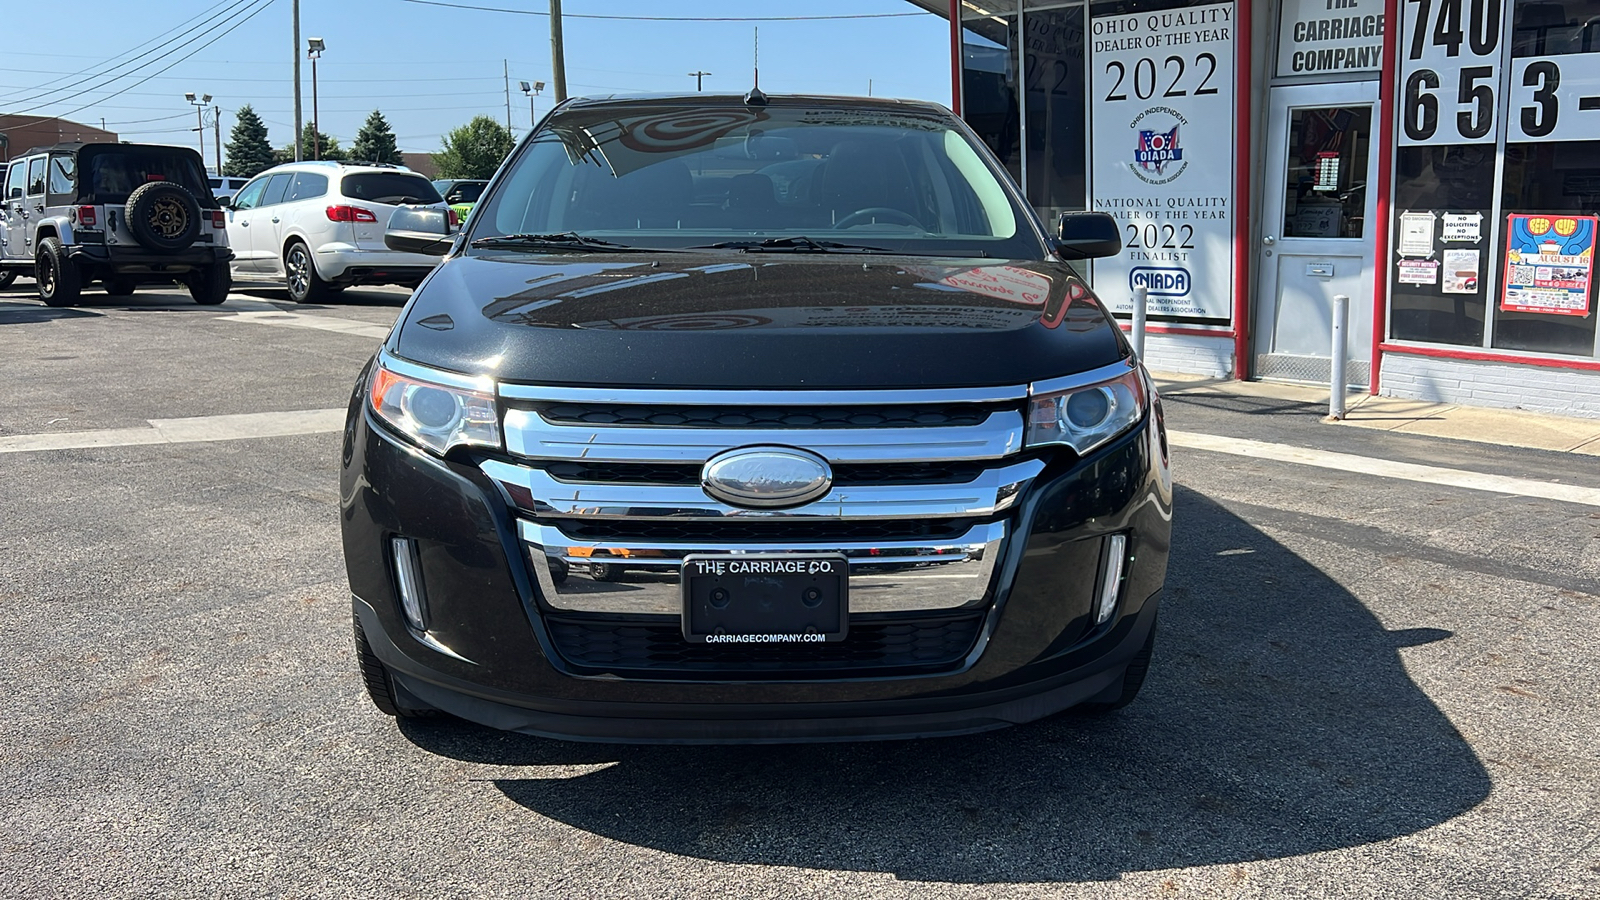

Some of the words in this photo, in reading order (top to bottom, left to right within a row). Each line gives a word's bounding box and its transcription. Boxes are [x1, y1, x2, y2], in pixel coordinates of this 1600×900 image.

[1093, 18, 1138, 36] OHIO
[1147, 7, 1233, 32] QUALITY
[1294, 15, 1384, 43] CARRIAGE
[1408, 0, 1499, 60] 740
[1095, 37, 1143, 53] DEALER
[1145, 35, 1162, 48] OF
[1165, 32, 1191, 46] THE
[1194, 28, 1230, 42] YEAR
[1292, 45, 1383, 72] COMPANY
[1105, 52, 1218, 101] 2022
[1130, 113, 1145, 129] OHIO
[1145, 106, 1188, 126] INDEPENDENT
[1140, 150, 1174, 161] OIADA
[1129, 163, 1149, 184] AUTOMOBILE
[1167, 161, 1188, 183] ASSOCIATION
[1095, 198, 1161, 208] NATIONAL
[1167, 197, 1228, 208] QUALITY
[1110, 210, 1140, 219] ALER
[1145, 210, 1160, 219] OF
[1165, 210, 1188, 219] THE
[1194, 210, 1226, 219] YEAR
[1529, 218, 1550, 234] BEER
[1126, 224, 1195, 249] 2022
[1130, 252, 1188, 261] FINALIST
[1538, 255, 1576, 263] AUGUST
[1134, 274, 1185, 290] NIADA
[696, 561, 725, 574] THE
[730, 561, 806, 573] CARRIAGE
[809, 561, 834, 573] CO.
[706, 634, 826, 643] CARRIAGECOMPANY.COM
